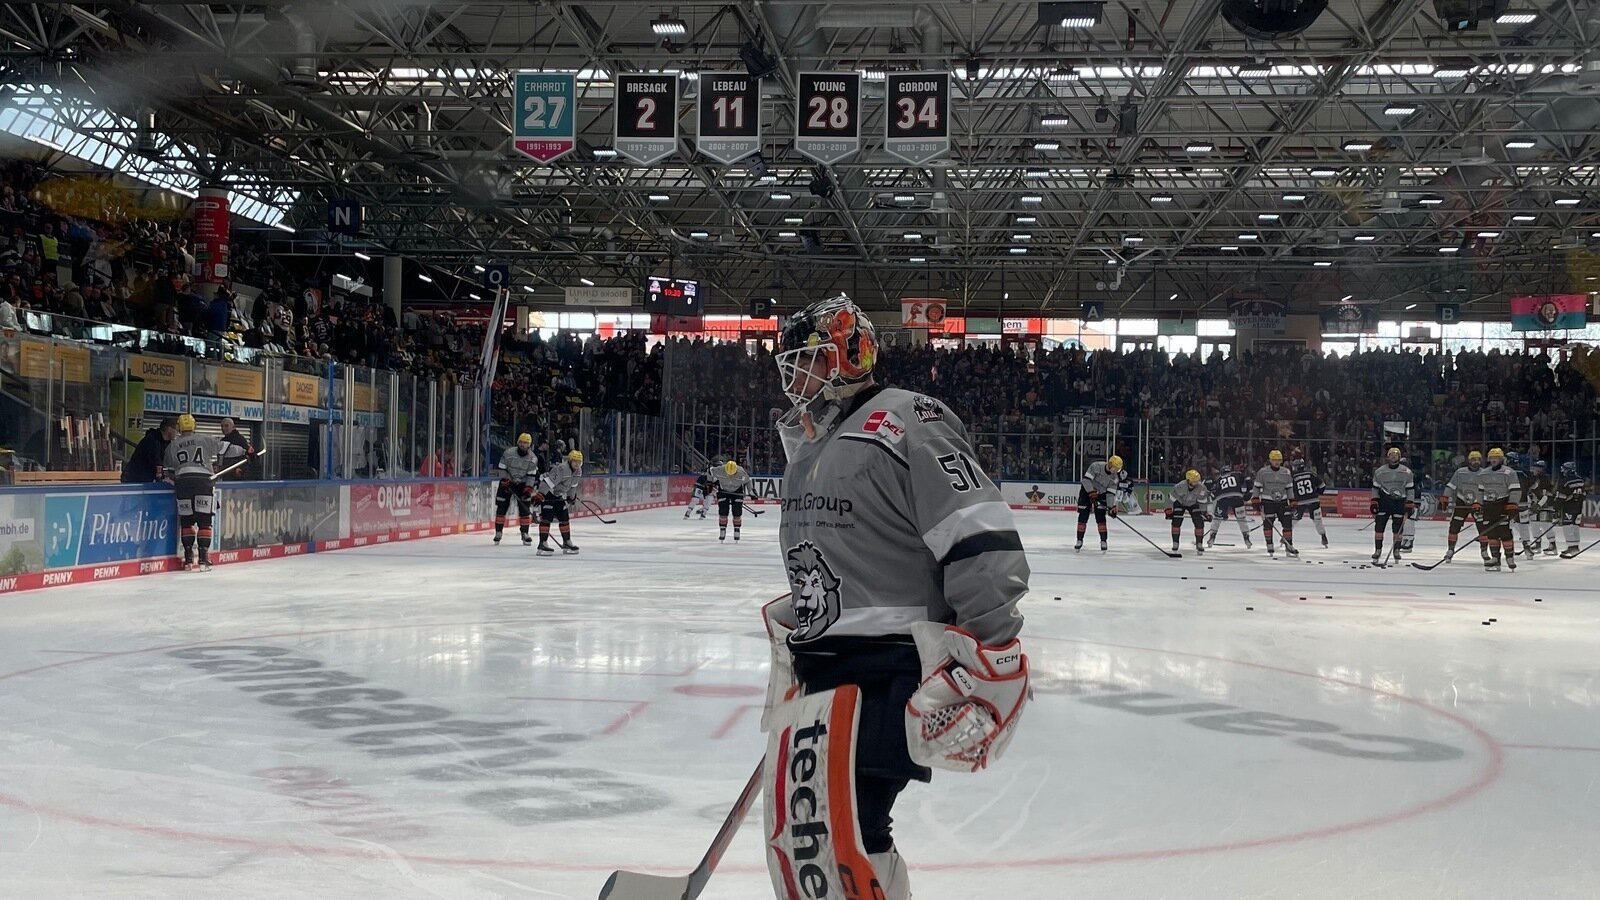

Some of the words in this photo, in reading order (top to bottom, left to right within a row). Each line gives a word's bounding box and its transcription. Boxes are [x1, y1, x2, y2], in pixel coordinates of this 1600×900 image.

[524, 82, 566, 92] ERHARDT
[627, 82, 667, 93] BRESAGK
[713, 81, 746, 92] LEBEAU
[813, 81, 846, 92] YOUNG
[899, 81, 937, 92] GORDON
[524, 96, 566, 129] 27
[637, 97, 656, 129] 2
[713, 97, 743, 128] 11
[808, 97, 848, 129] 28
[897, 97, 938, 129] 34
[335, 206, 351, 226] N
[489, 270, 503, 284] O
[755, 303, 765, 315] P
[1087, 306, 1099, 319] A
[1442, 307, 1454, 320] B
[143, 361, 175, 377] DACHSER
[145, 393, 177, 411] BAHN
[936, 451, 983, 493] 51
[1219, 476, 1237, 490] 20
[1297, 479, 1313, 496] 53
[378, 485, 411, 513] ORION
[224, 499, 293, 539] Bitburger
[89, 510, 168, 546] Plus.line
[995, 655, 1019, 665] CCM
[955, 670, 973, 690] CCM
[791, 719, 828, 900] teche
